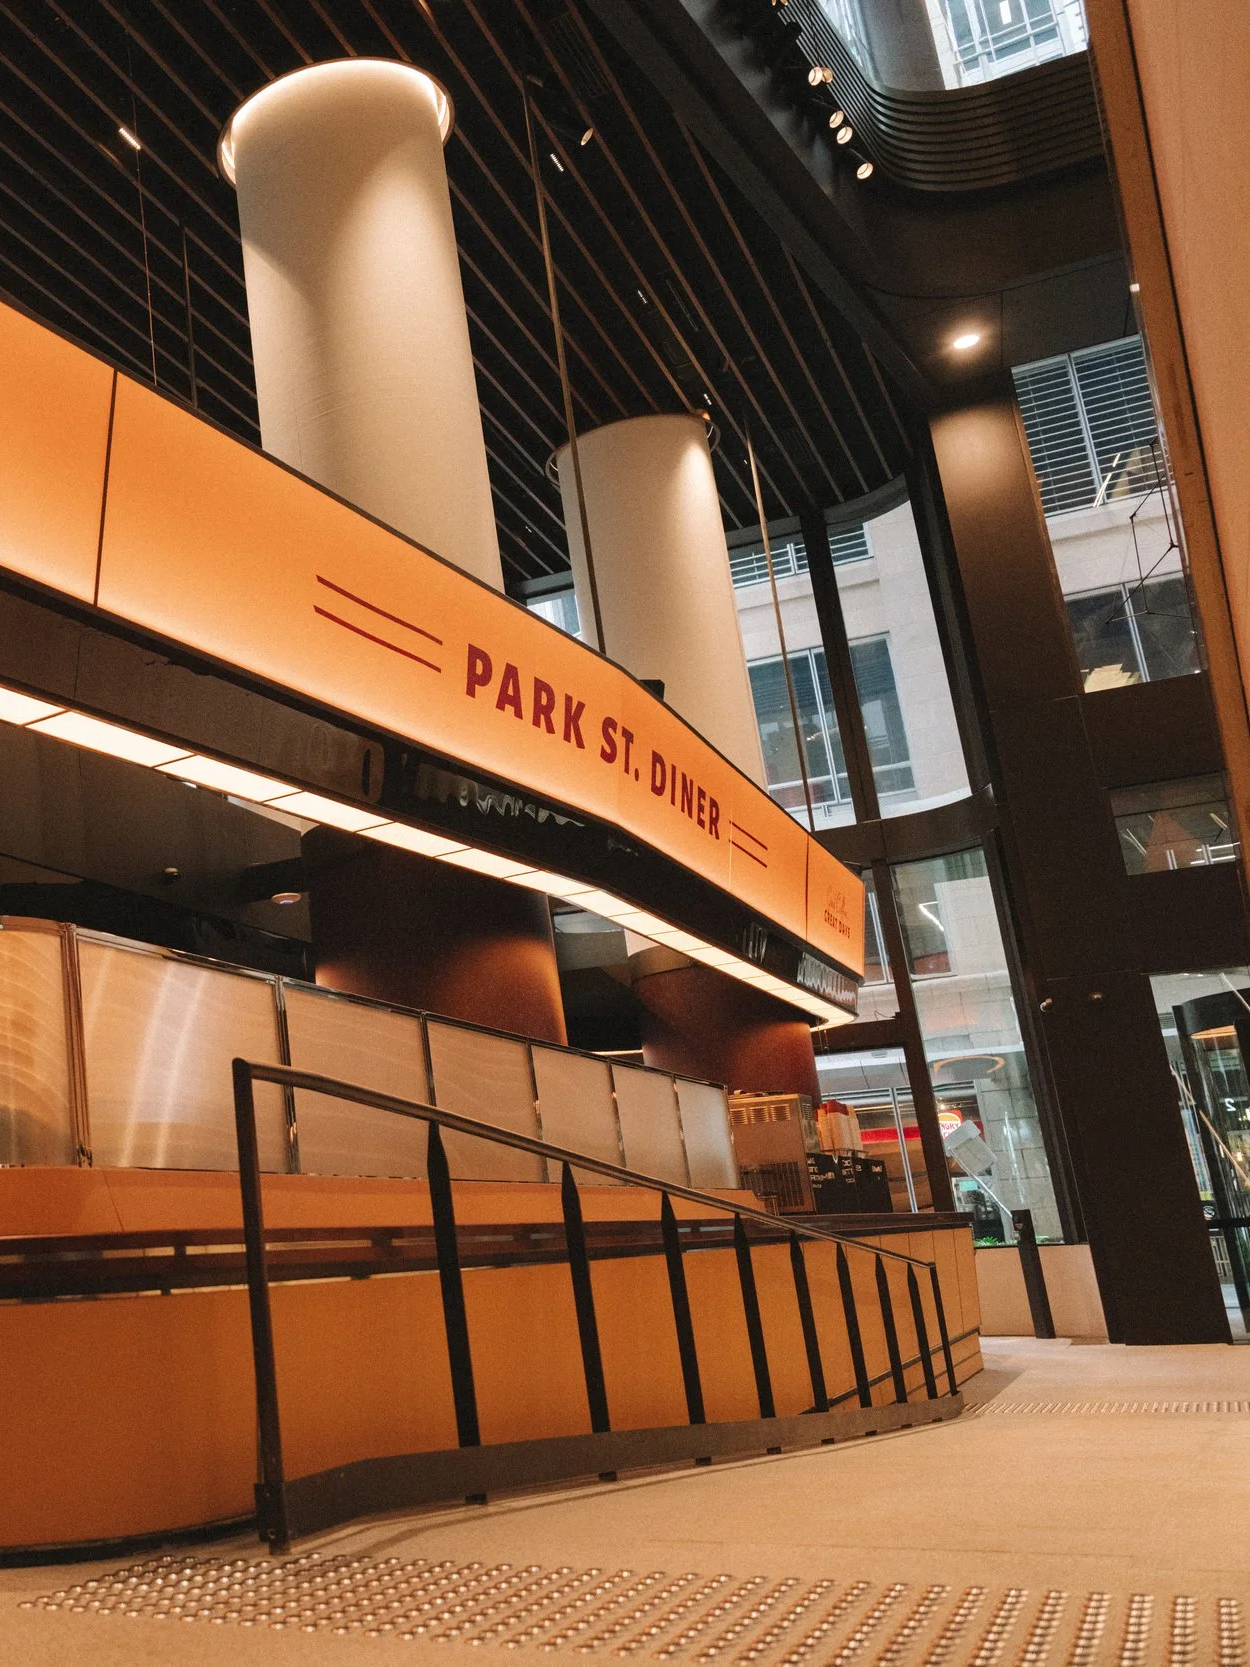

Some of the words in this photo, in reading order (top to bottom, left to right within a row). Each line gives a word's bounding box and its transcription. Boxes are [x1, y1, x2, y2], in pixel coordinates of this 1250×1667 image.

[465, 643, 586, 749] PARK
[599, 716, 640, 782] ST.
[651, 749, 720, 840] DINER
[838, 920, 851, 939] DAYS
[940, 1122, 959, 1130] NGRY
